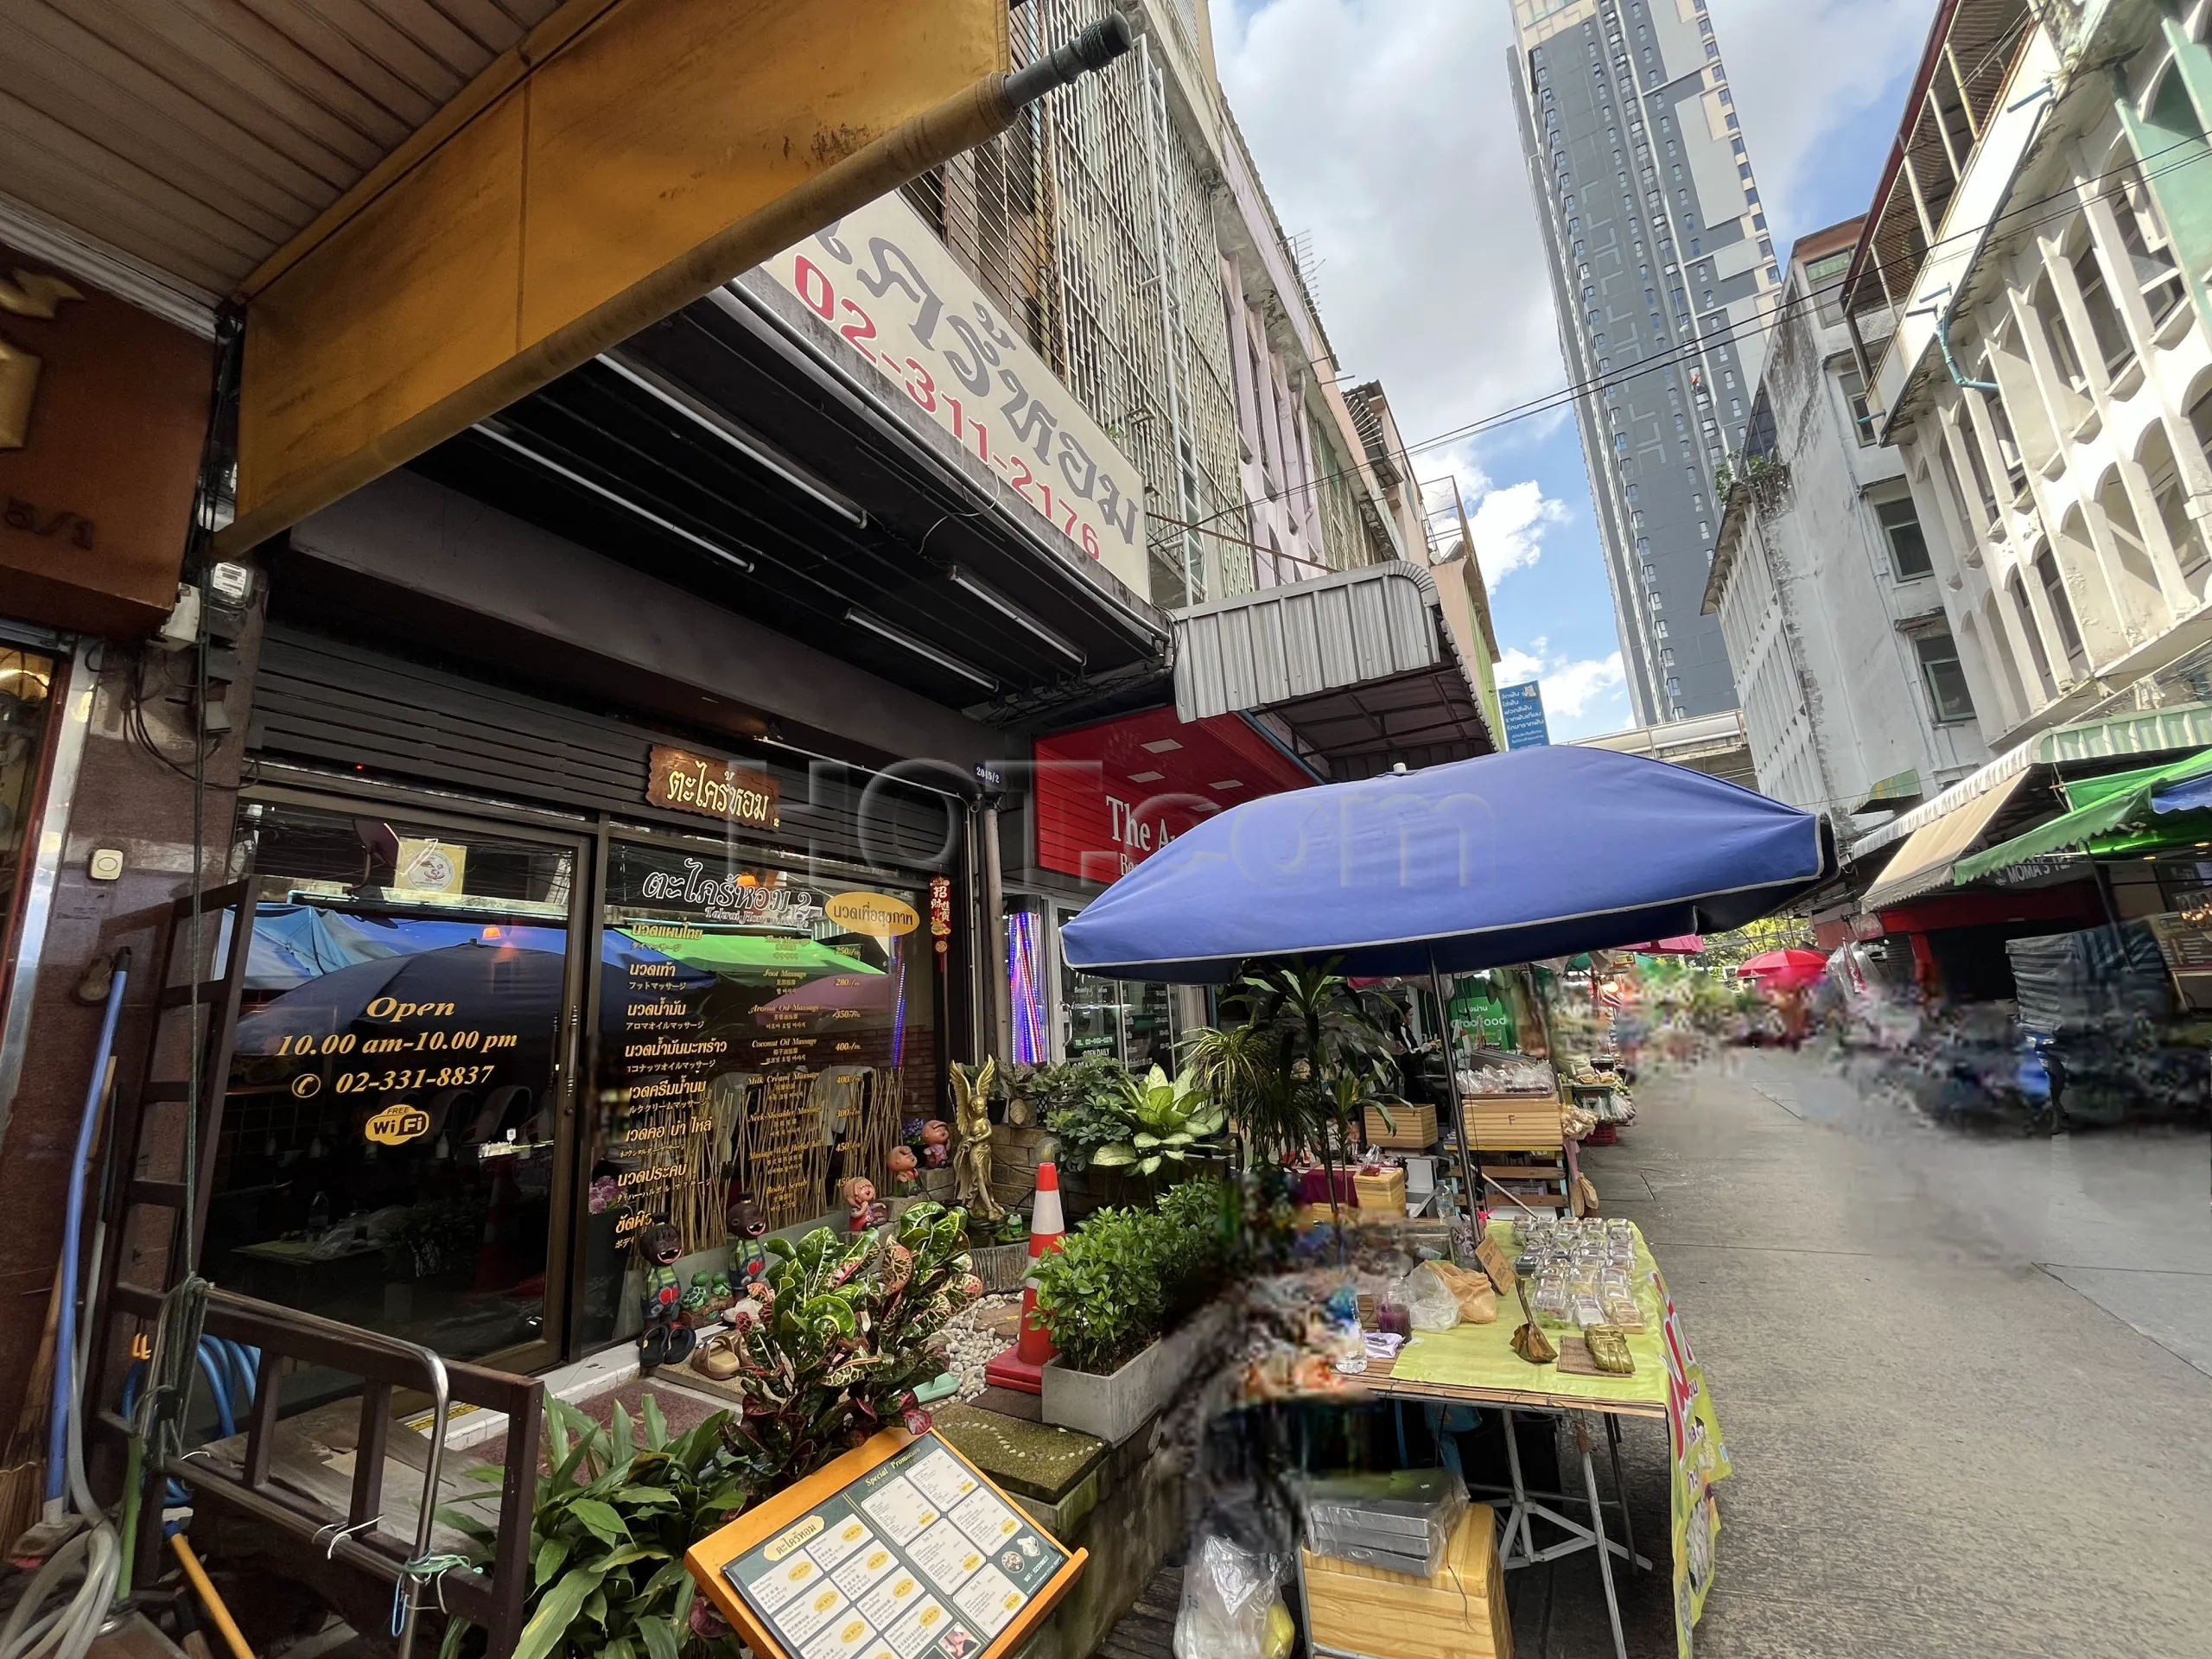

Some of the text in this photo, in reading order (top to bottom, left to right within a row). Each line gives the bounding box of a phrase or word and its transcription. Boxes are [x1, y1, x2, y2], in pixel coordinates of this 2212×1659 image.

[816, 218, 1139, 544] คร้หอม
[794, 254, 1101, 561] 02-311-2176
[666, 760, 770, 822] ตะไคร้หอม
[1106, 795, 1151, 851] The
[642, 857, 812, 920] ตะไคร้หอม 2
[833, 900, 913, 927] นวดเพื่อสุขภาพ
[632, 922, 704, 941] นวดแผนไทย
[629, 961, 677, 977] นวดเท้า
[780, 969, 807, 980] Massage
[366, 996, 455, 1023] Open
[627, 996, 687, 1016] นวดน้ำมัน
[791, 1002, 820, 1013] Massage
[626, 1020, 705, 1031] アロマオイルマッサージ
[276, 1033, 357, 1057] 10.00
[481, 1033, 518, 1054] pm
[625, 1036, 728, 1058] นวดน้ำมันมะพร้าว
[752, 1039, 778, 1048] Coconut
[792, 1038, 817, 1047] Massage
[335, 1065, 496, 1094] 02-331-8837
[747, 1071, 821, 1085] Milk Cream Massage
[386, 1107, 410, 1116] FREE
[690, 1116, 714, 1134] ไหล่
[617, 1163, 688, 1187] นวดประคบ
[865, 1467, 889, 1486] Special
[890, 1446, 921, 1470] Promotion
